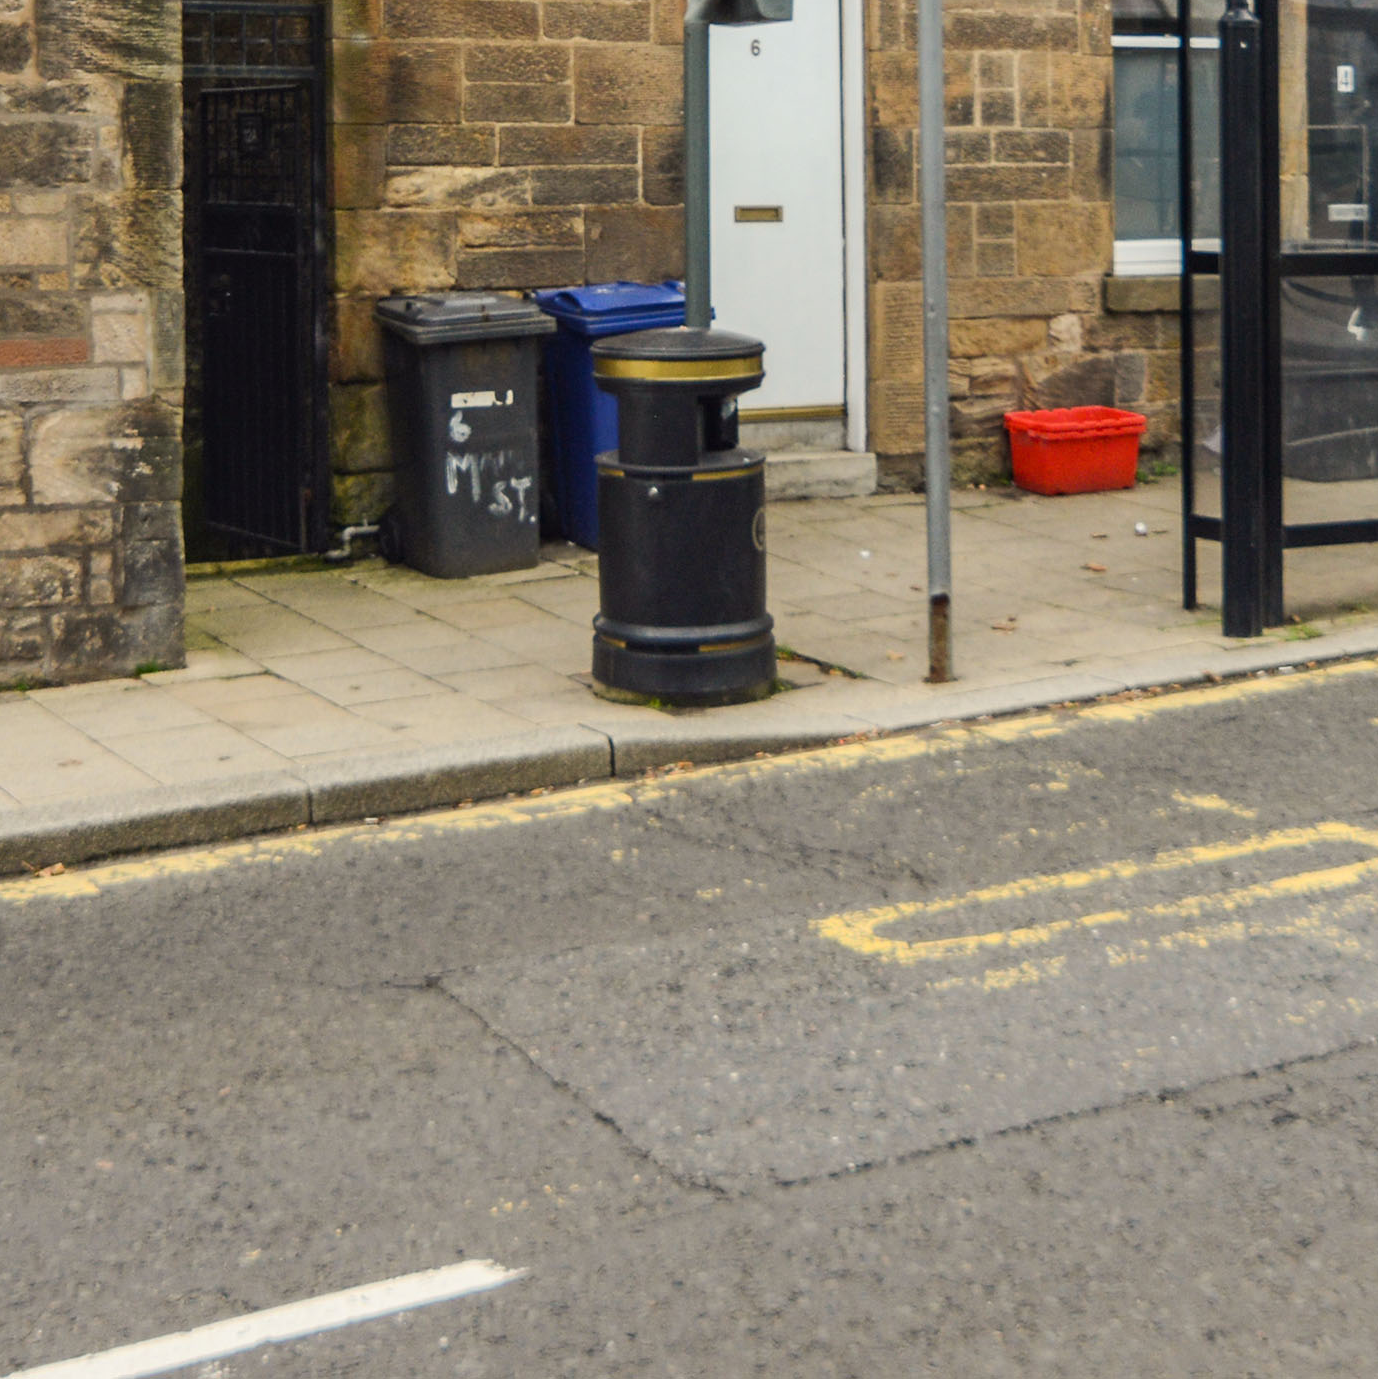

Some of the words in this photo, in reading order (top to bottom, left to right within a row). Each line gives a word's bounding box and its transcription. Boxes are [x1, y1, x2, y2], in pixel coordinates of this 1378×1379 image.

[750, 39, 761, 57] 6
[1339, 68, 1350, 89] 4
[449, 410, 472, 443] 6
